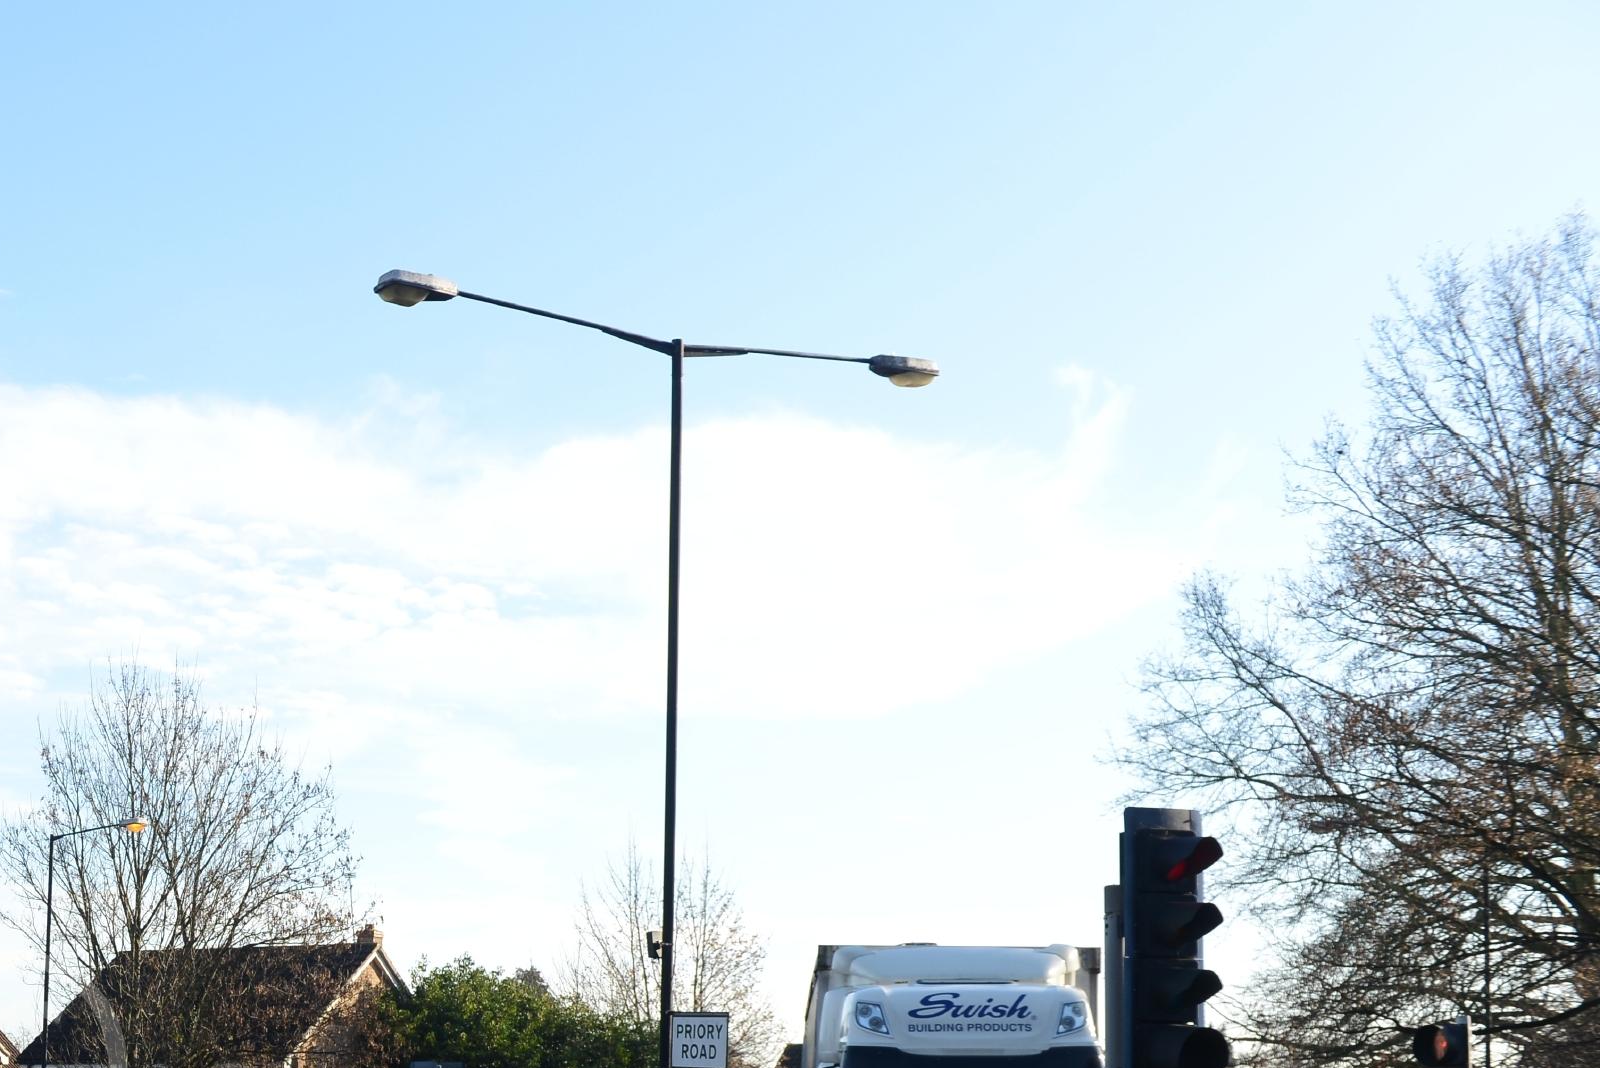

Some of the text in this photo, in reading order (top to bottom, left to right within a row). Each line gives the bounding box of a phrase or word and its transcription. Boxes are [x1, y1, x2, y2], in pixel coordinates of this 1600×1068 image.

[907, 992, 1032, 1019] Swish
[676, 1023, 724, 1040] PRIORY
[907, 1023, 1033, 1033] BUILDING PRODUCTS
[681, 1044, 718, 1060] ROAD
